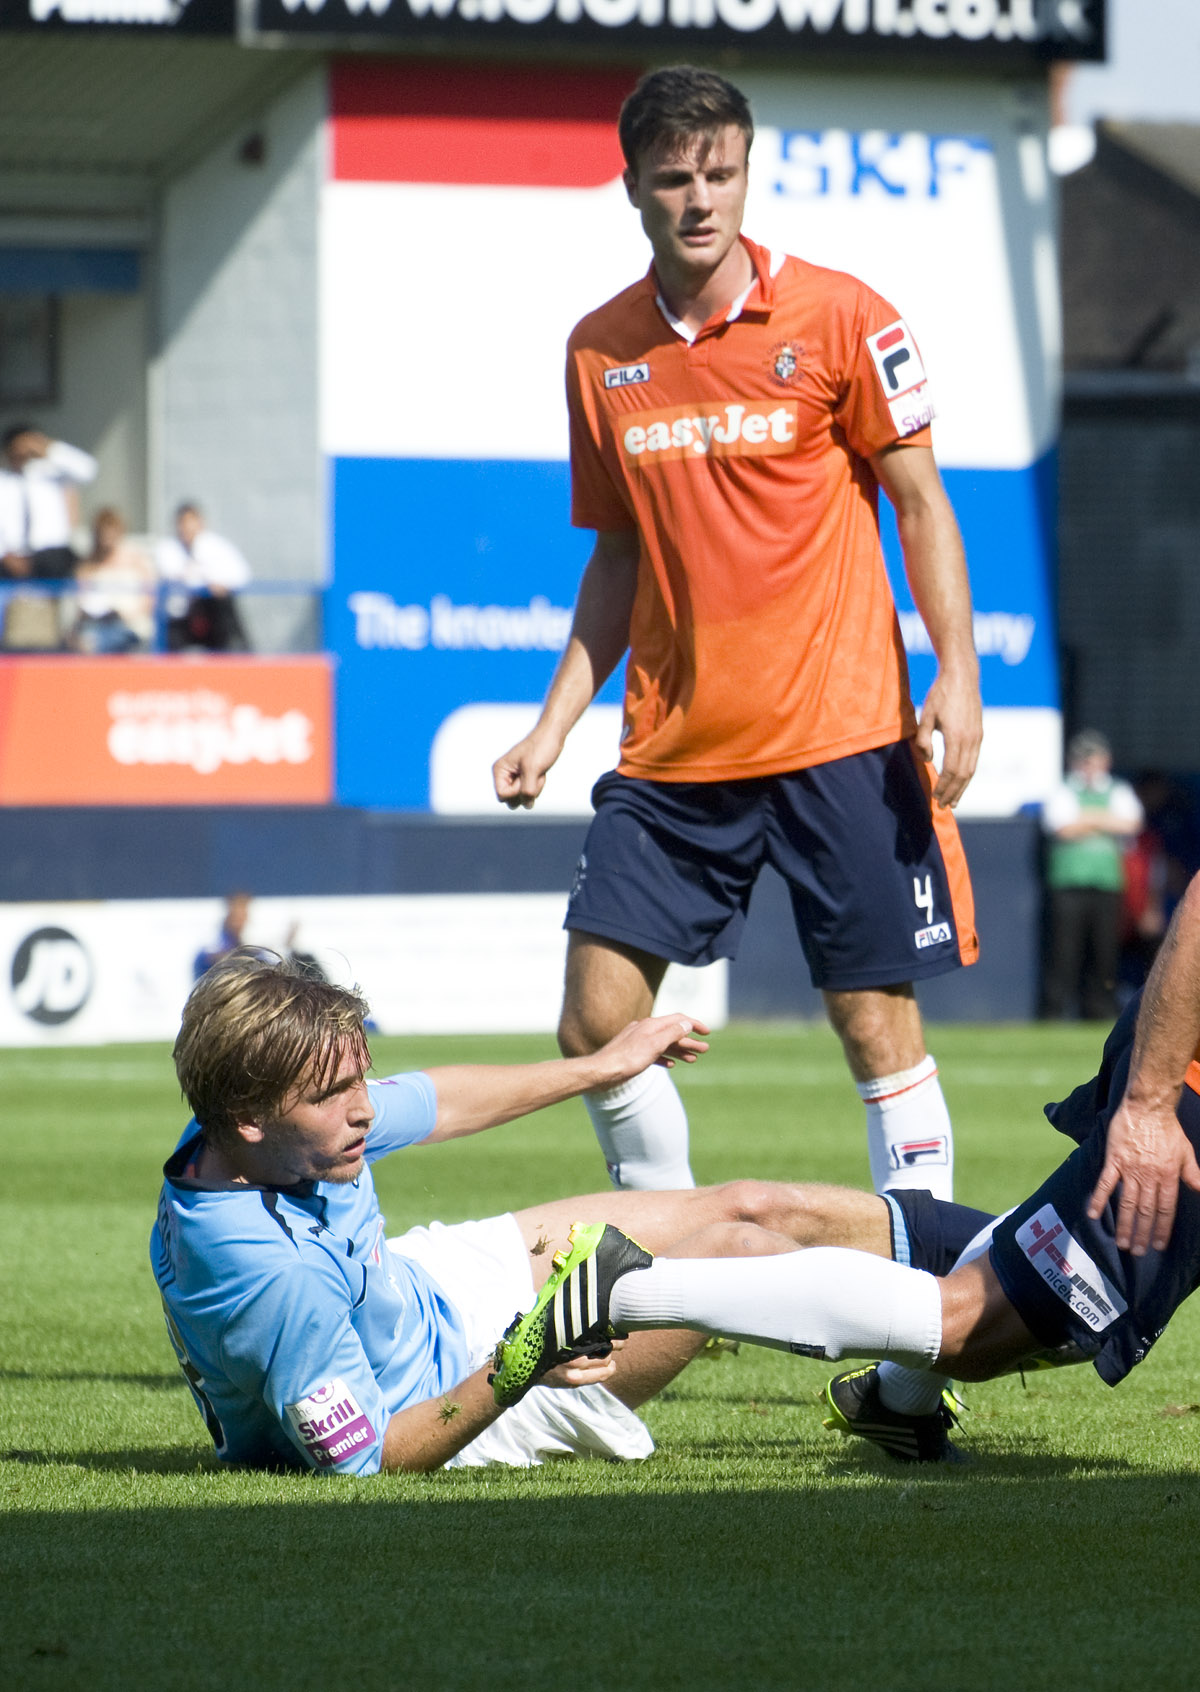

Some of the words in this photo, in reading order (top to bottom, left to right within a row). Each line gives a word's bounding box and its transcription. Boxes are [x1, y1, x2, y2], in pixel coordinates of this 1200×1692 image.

[775, 129, 993, 198] SKF
[608, 368, 645, 387] FILA
[624, 404, 794, 454] easyJet
[348, 591, 428, 650] The
[108, 704, 313, 774] easyJet
[913, 874, 933, 925] 4
[919, 927, 947, 948] FILA
[15, 939, 89, 1012] JD
[1043, 1268, 1100, 1326] niceic.com
[298, 1398, 355, 1441] Skrill
[313, 1426, 368, 1461] Premier
